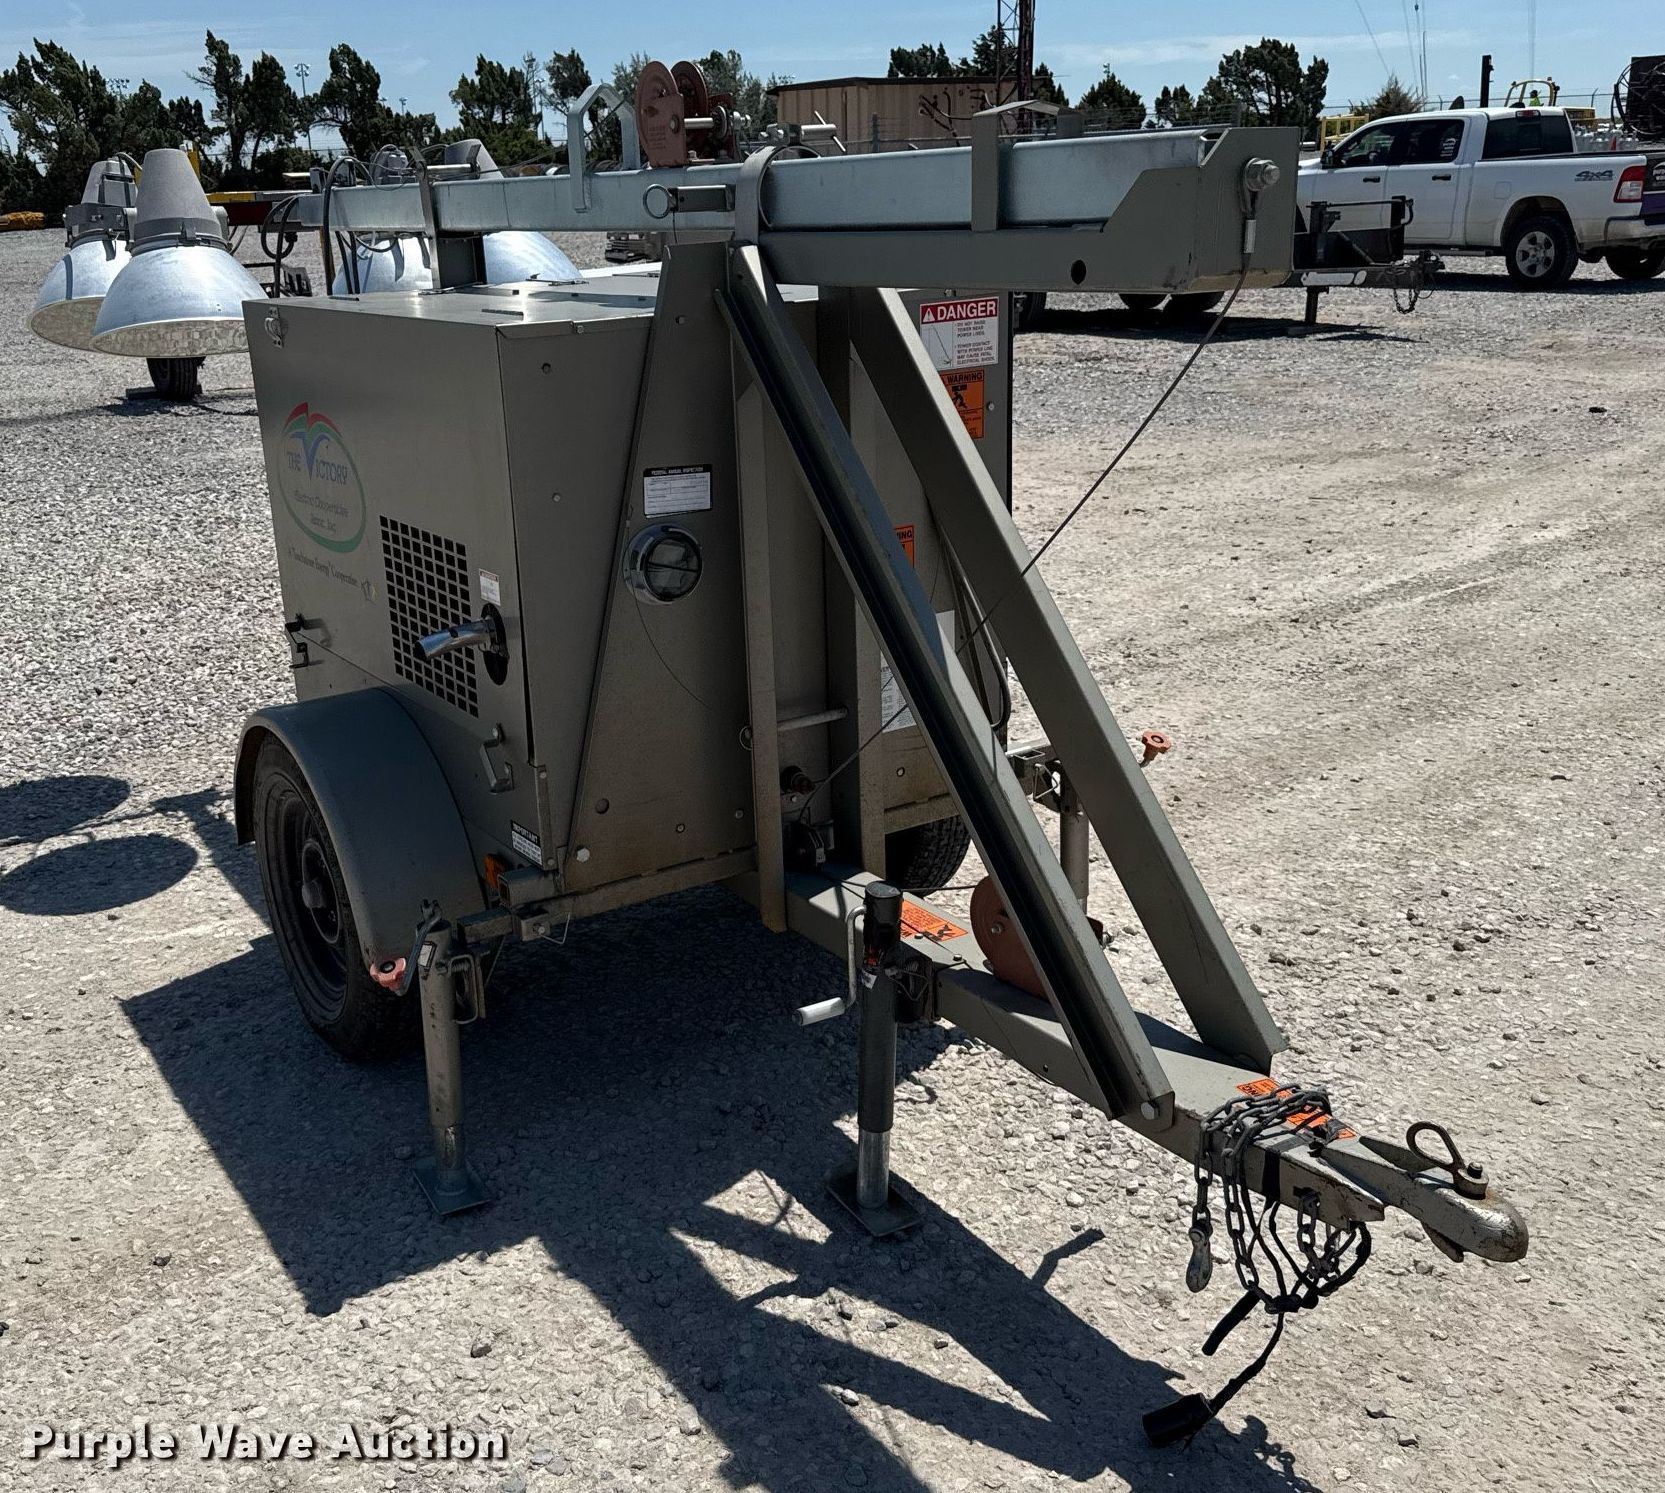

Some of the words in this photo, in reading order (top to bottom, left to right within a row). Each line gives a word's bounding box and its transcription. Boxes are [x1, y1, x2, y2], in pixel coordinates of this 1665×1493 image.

[937, 301, 996, 321] DANGER
[947, 372, 983, 383] WARNING
[286, 450, 301, 472] THE
